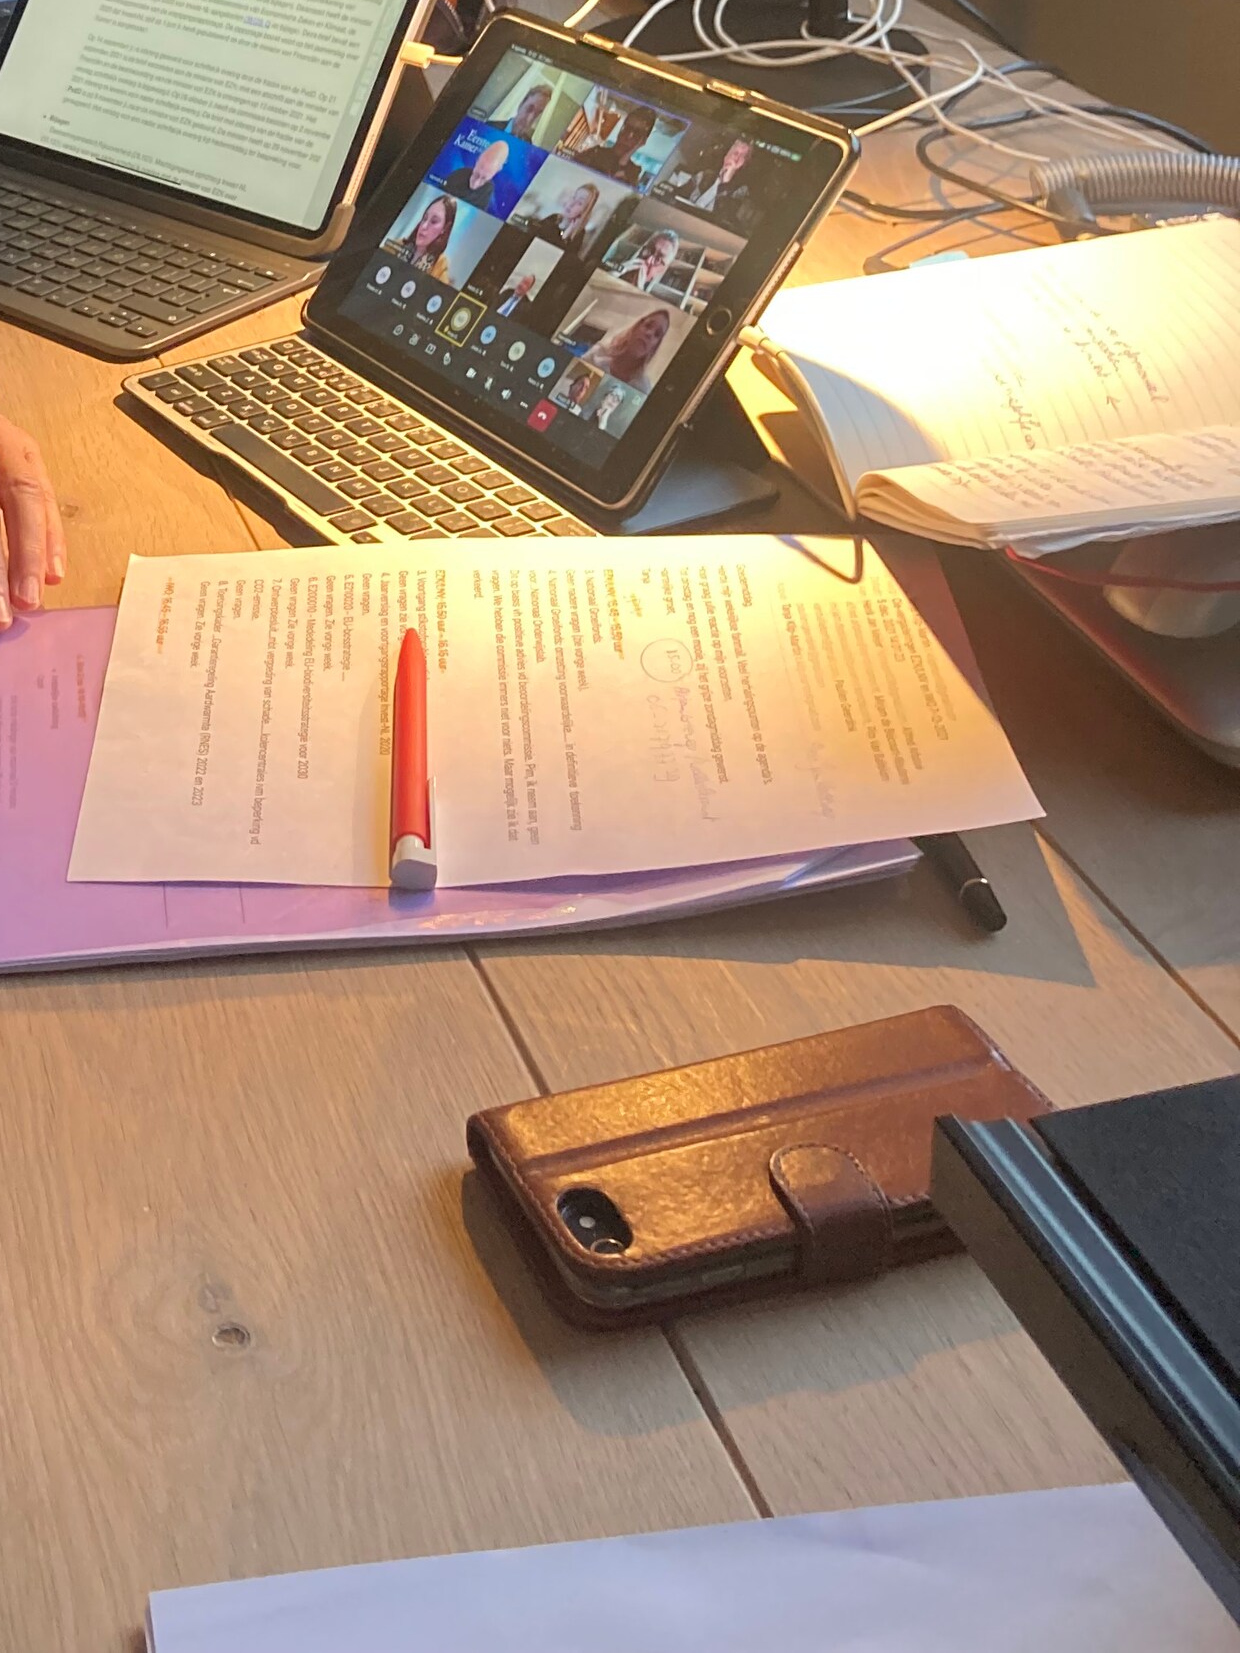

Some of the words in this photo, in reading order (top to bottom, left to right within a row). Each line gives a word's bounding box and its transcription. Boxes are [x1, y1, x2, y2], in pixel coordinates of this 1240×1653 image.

[290, 578, 300, 594] Geen
[326, 576, 336, 592] Geen
[362, 573, 371, 589] Geen
[399, 570, 408, 587] Geen
[199, 581, 210, 597] Geen
[378, 580, 389, 616] Jaarverslag
[396, 588, 406, 610] vragen
[415, 577, 428, 611] Voortgang
[512, 590, 522, 606] basis
[568, 588, 579, 609] nadere
[193, 598, 206, 619] vragen.
[250, 579, 265, 620] CO2-emissie.
[285, 595, 297, 617] vragen
[322, 594, 333, 617] vragen.
[359, 591, 369, 615] vragen.
[210, 588, 227, 633] Toetsingskader
[398, 612, 408, 623] zie
[494, 607, 504, 632] hebben
[686, 612, 697, 624] nog
[194, 621, 205, 630] Zie
[287, 619, 297, 629] Zie
[323, 619, 334, 629] Zie
[569, 611, 580, 633] vragen
[690, 625, 700, 638] een
[707, 616, 720, 638] reactie
[189, 632, 204, 650] vorige
[282, 631, 296, 650] vorige
[302, 619, 315, 656] Mededeling
[320, 631, 333, 651] vorige
[495, 634, 505, 643] die
[512, 618, 525, 647] positieve
[338, 617, 352, 670] EU-bosstrategie
[691, 639, 706, 661] mooie,
[283, 651, 294, 669] week.
[321, 653, 332, 671] week.
[377, 628, 389, 702] voortgangsrapportage
[496, 645, 508, 680] commissie
[516, 649, 527, 669] advies
[552, 646, 567, 679] omzetting
[573, 647, 586, 667] vorige
[711, 649, 725, 663] mijn
[261, 650, 277, 684] vergoeding
[695, 663, 708, 671] zij
[699, 672, 710, 682] het
[262, 686, 272, 698] van
[297, 657, 314, 742] EU-biodiversiteitsstrategie
[498, 682, 509, 705] immers
[699, 684, 714, 702] grijze
[200, 688, 215, 730] Aardwarmte
[379, 703, 389, 735] Invest-NL
[500, 707, 510, 720] niet
[501, 721, 510, 736] voor
[516, 681, 534, 762] beoordelingscommissie.
[703, 703, 724, 752] zondagmiddag
[194, 732, 211, 755] (RNES)
[298, 743, 308, 759] voor
[379, 736, 389, 755] 2020
[502, 738, 513, 756] niets.
[195, 757, 208, 774] 2022
[297, 760, 309, 778] 2030
[503, 759, 514, 776] Maar
[522, 763, 536, 779] Pim,
[564, 751, 578, 788] definitieve
[712, 753, 730, 783] gewenst.
[754, 753, 772, 785] agenda's.
[191, 786, 204, 806] 2023
[254, 783, 266, 796] ivm
[502, 777, 516, 808] mogelijk
[526, 789, 536, 809] neem
[248, 797, 265, 834] beperking
[506, 809, 517, 820] zie
[525, 810, 537, 825] aan,
[566, 791, 583, 831] toekenning
[507, 829, 519, 841] dat
[526, 827, 539, 844] geen
